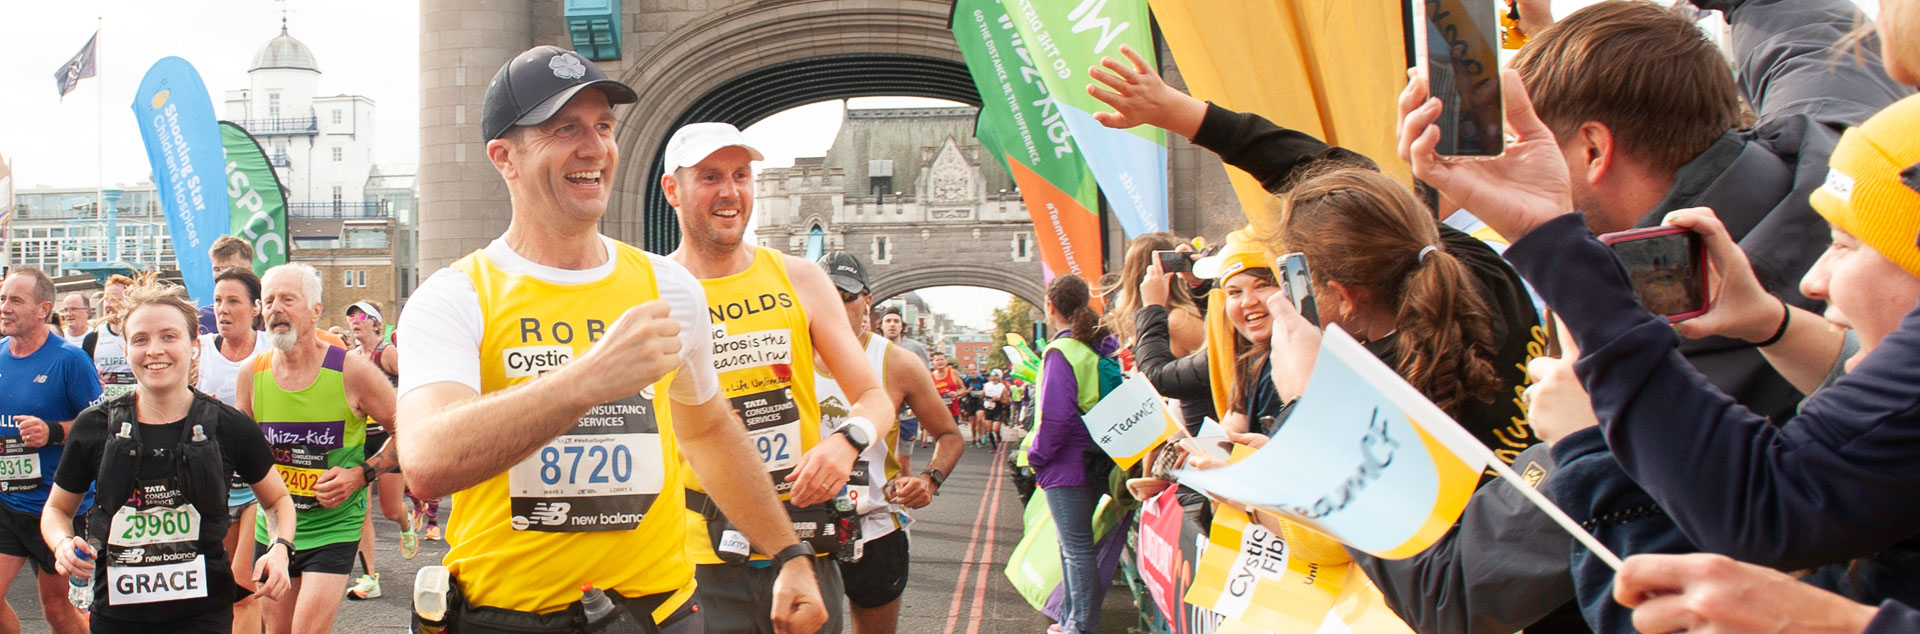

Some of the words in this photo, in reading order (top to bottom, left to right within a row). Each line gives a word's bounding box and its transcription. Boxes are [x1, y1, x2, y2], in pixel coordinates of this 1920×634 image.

[973, 9, 984, 22] GO
[979, 21, 992, 40] THE
[1002, 82, 1013, 96] BE
[1007, 94, 1020, 113] THE
[164, 103, 195, 179] Shooting
[187, 175, 206, 211] Star
[153, 115, 180, 182] Children's
[173, 180, 200, 248] Hospices
[508, 350, 569, 371] Cystic
[585, 404, 647, 416] NSULTANCY
[743, 399, 768, 408] TATA
[578, 416, 625, 427] SERVICES
[747, 413, 781, 425] SERVICES
[756, 433, 790, 463] 92
[540, 444, 632, 485] 8720
[122, 510, 191, 539] 29960
[572, 516, 597, 526] new
[145, 555, 162, 563] new
[163, 552, 196, 561] balance
[1229, 528, 1268, 597] Cystic
[116, 570, 198, 595] GRACE
